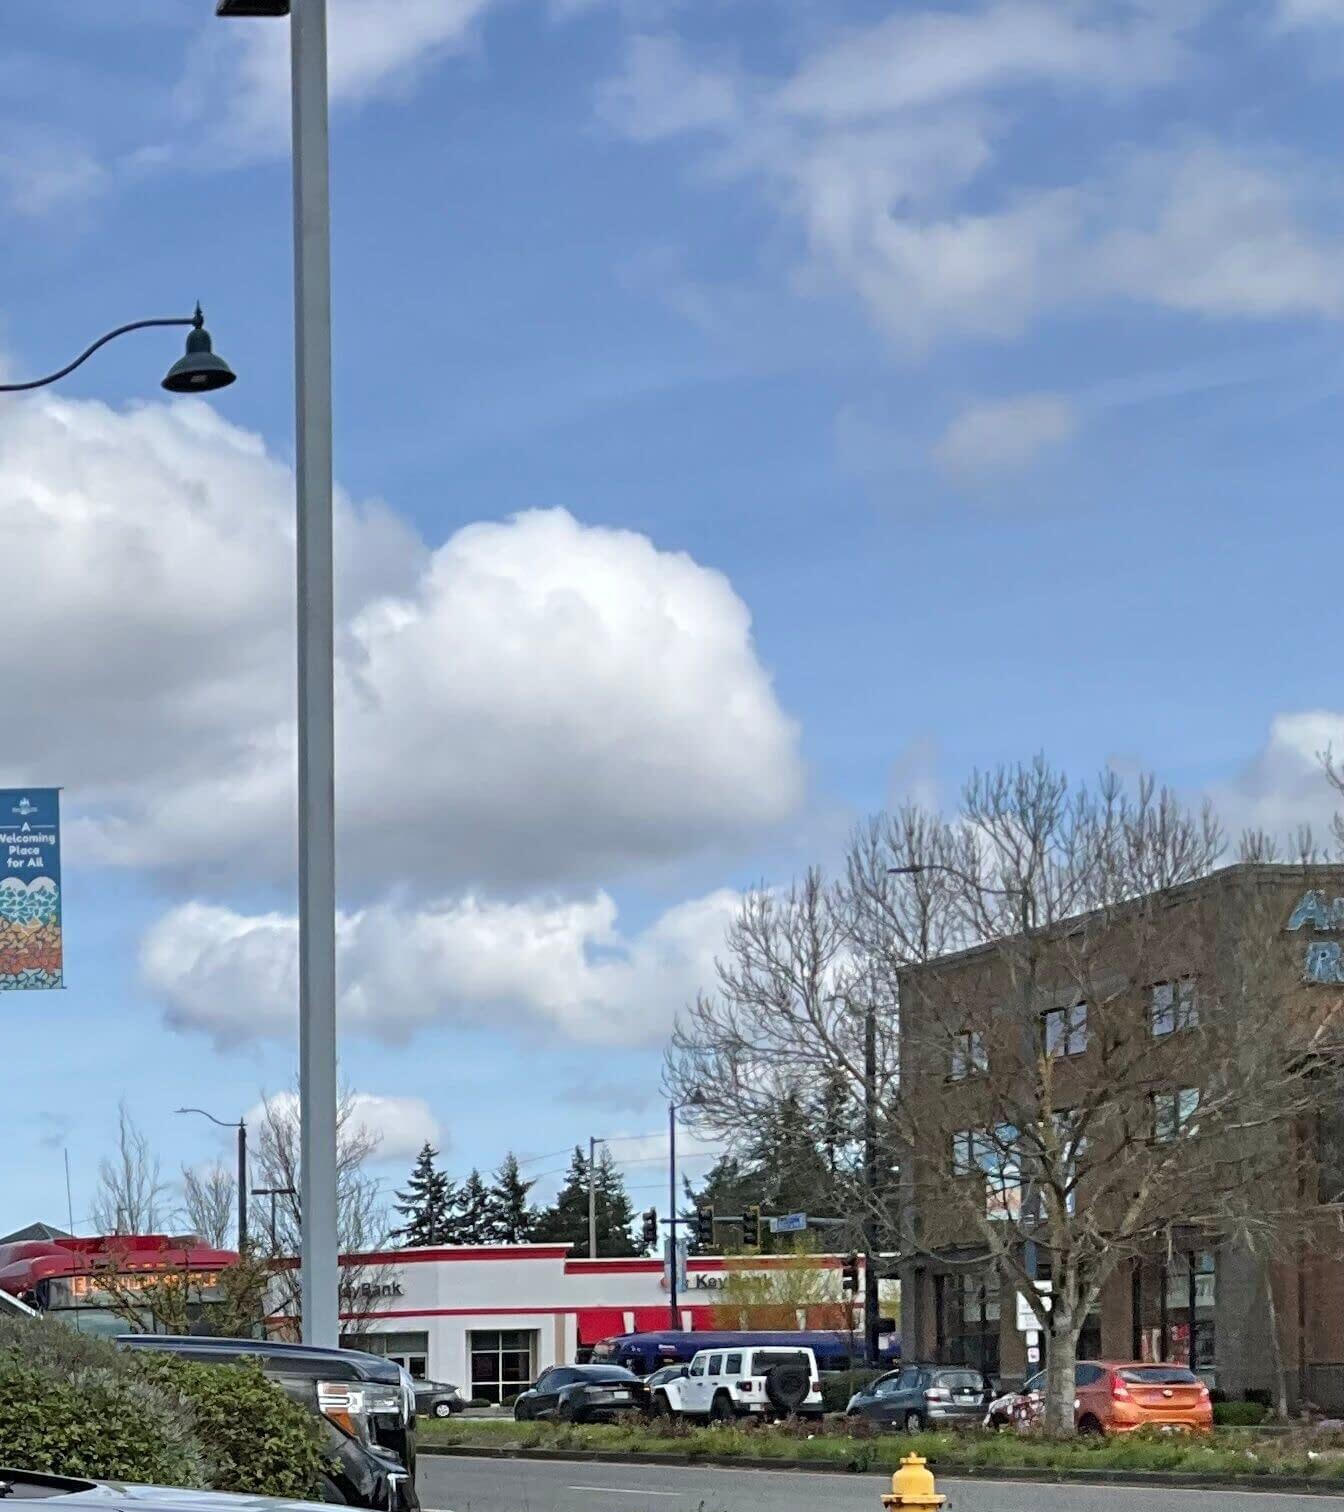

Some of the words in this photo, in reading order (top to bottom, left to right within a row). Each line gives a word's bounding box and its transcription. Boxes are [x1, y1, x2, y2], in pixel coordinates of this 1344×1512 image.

[21, 822, 31, 832] A
[9, 845, 40, 855] Place
[7, 857, 25, 868] for
[27, 856, 44, 868] All
